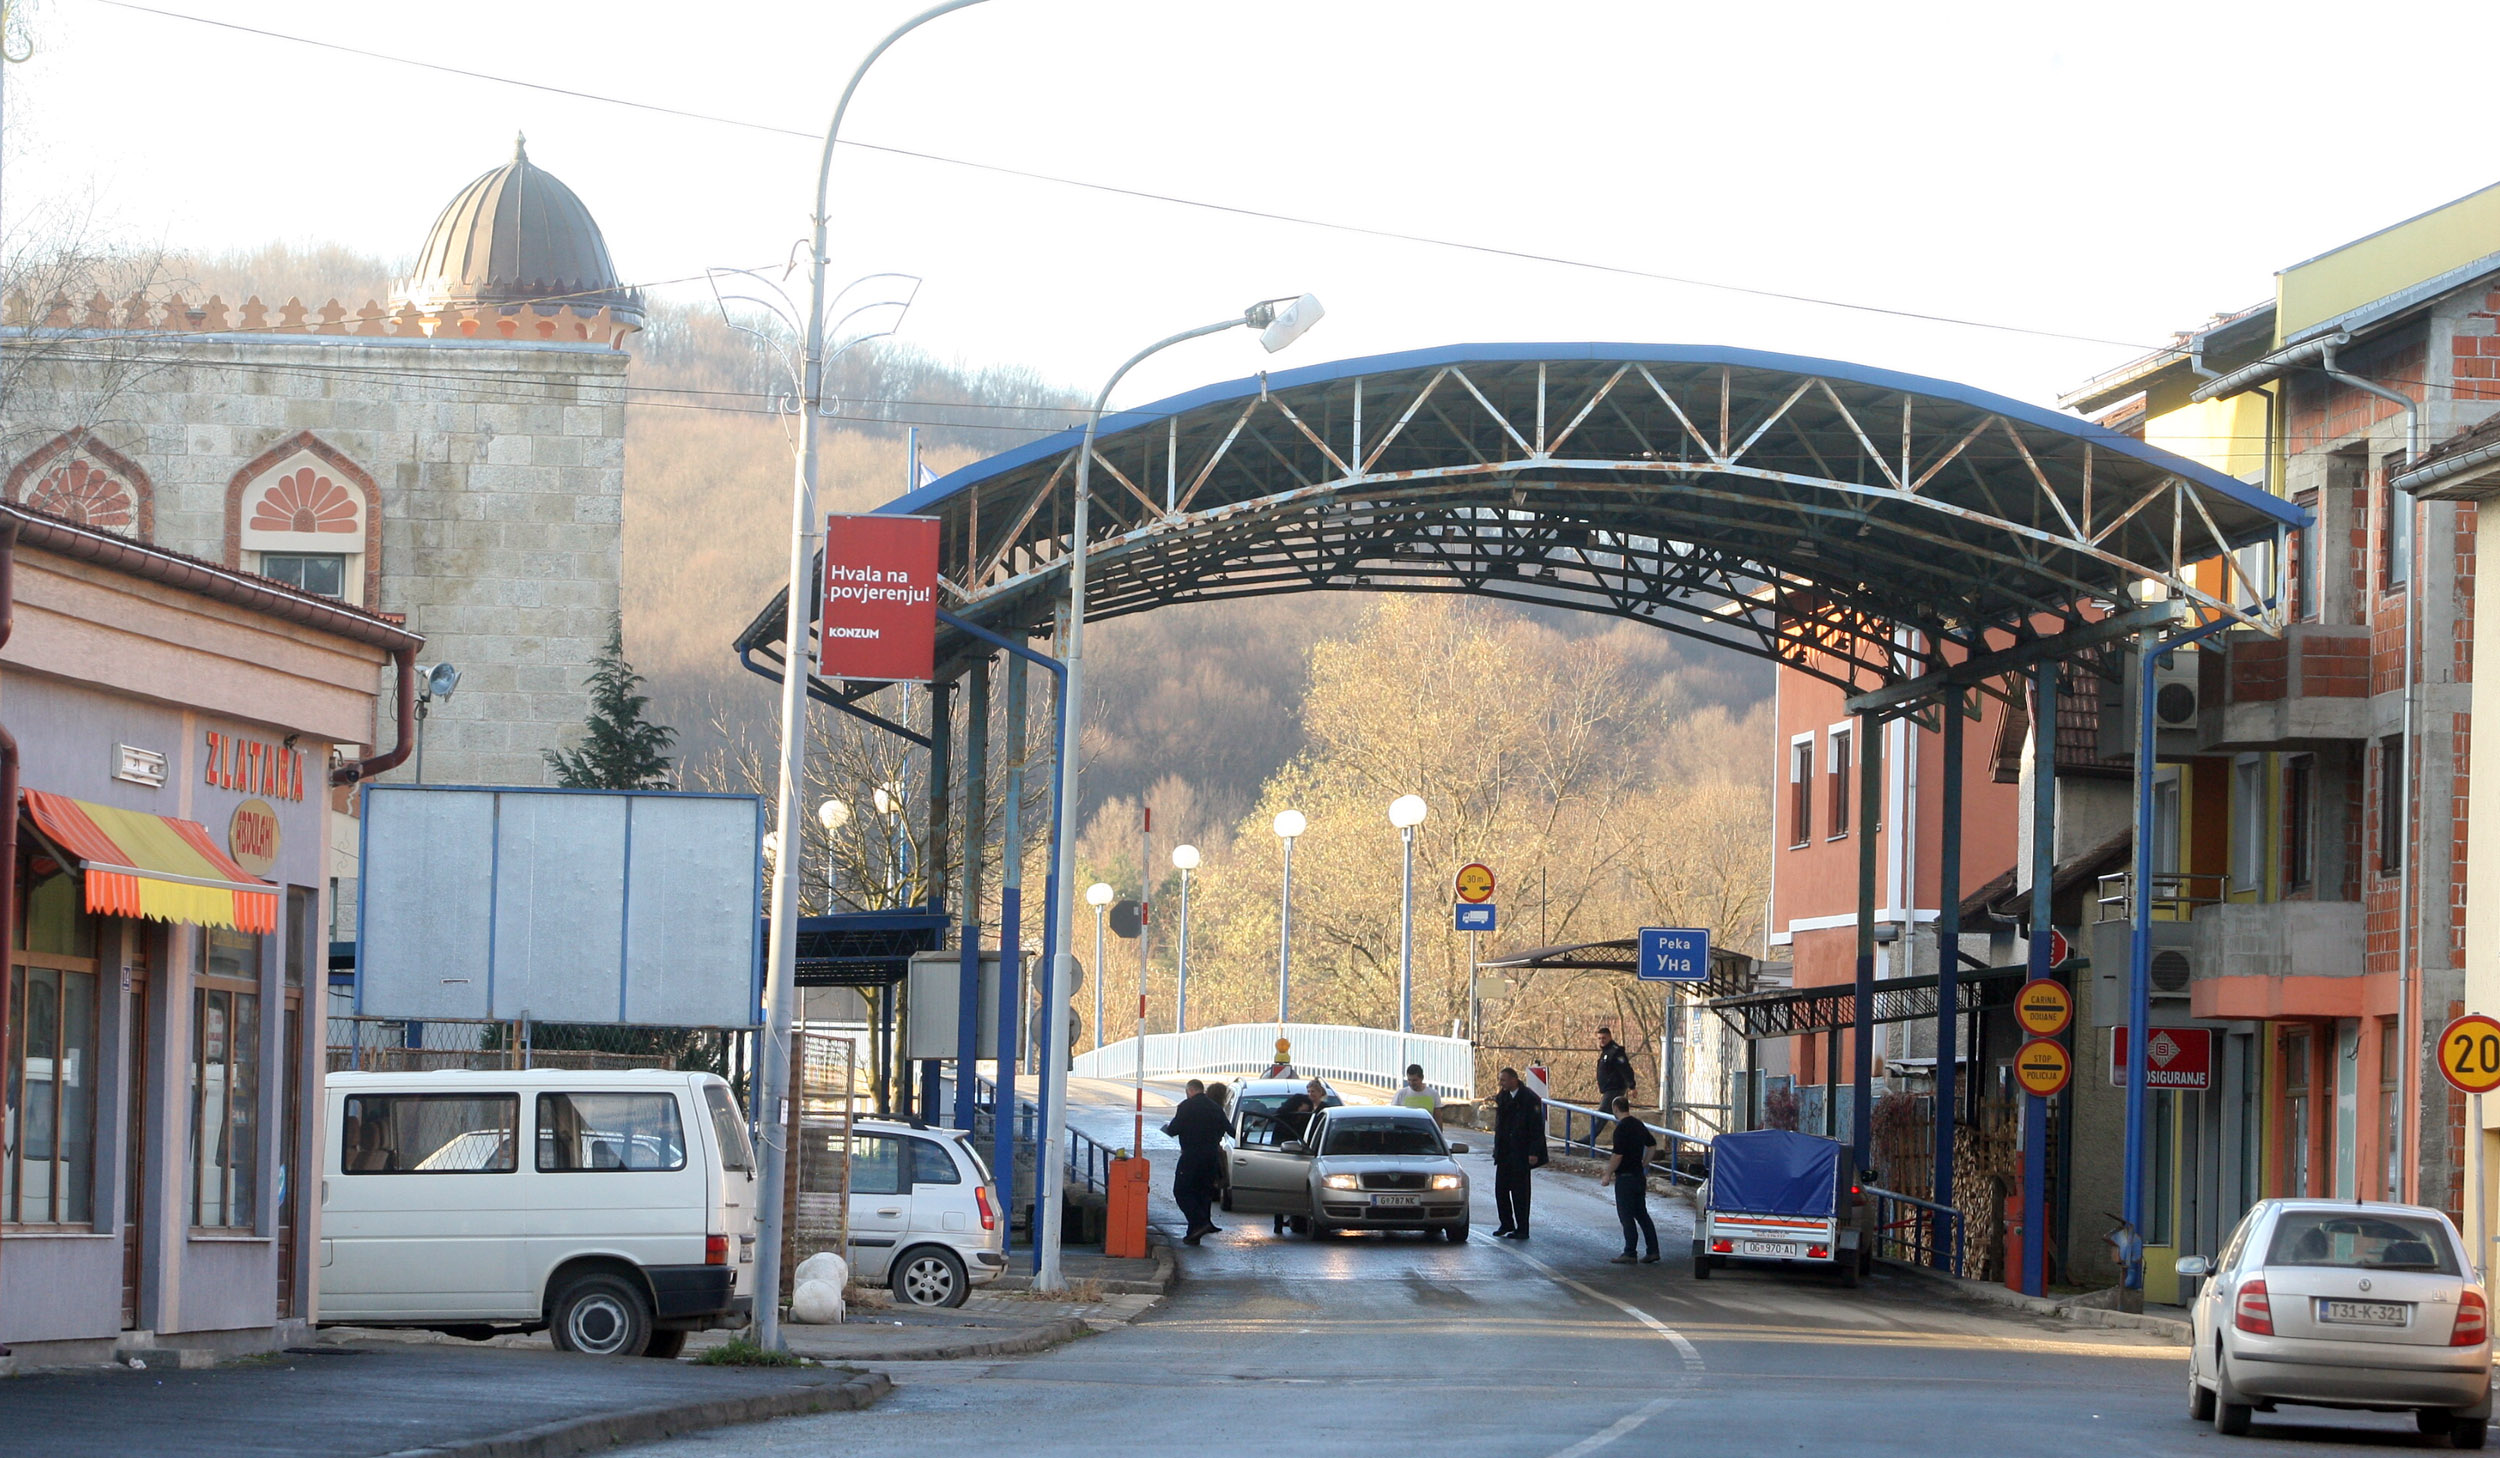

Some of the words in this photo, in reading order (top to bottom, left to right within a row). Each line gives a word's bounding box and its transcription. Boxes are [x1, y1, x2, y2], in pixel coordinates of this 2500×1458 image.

[831, 564, 882, 582] Hvala
[887, 570, 908, 583] na
[830, 583, 930, 606] povjerenju!
[828, 627, 880, 639] KONZUM
[206, 731, 304, 802] ZLATARA
[1467, 875, 1476, 883] 30
[1659, 937, 1690, 950] Река
[1657, 954, 1691, 971] Уна
[2030, 995, 2057, 1004] CARINA
[2029, 1012, 2057, 1021] DOUANE
[2033, 1054, 2052, 1063] STOP
[2453, 1034, 2500, 1074] 20
[2026, 1071, 2057, 1080] POLICIJA
